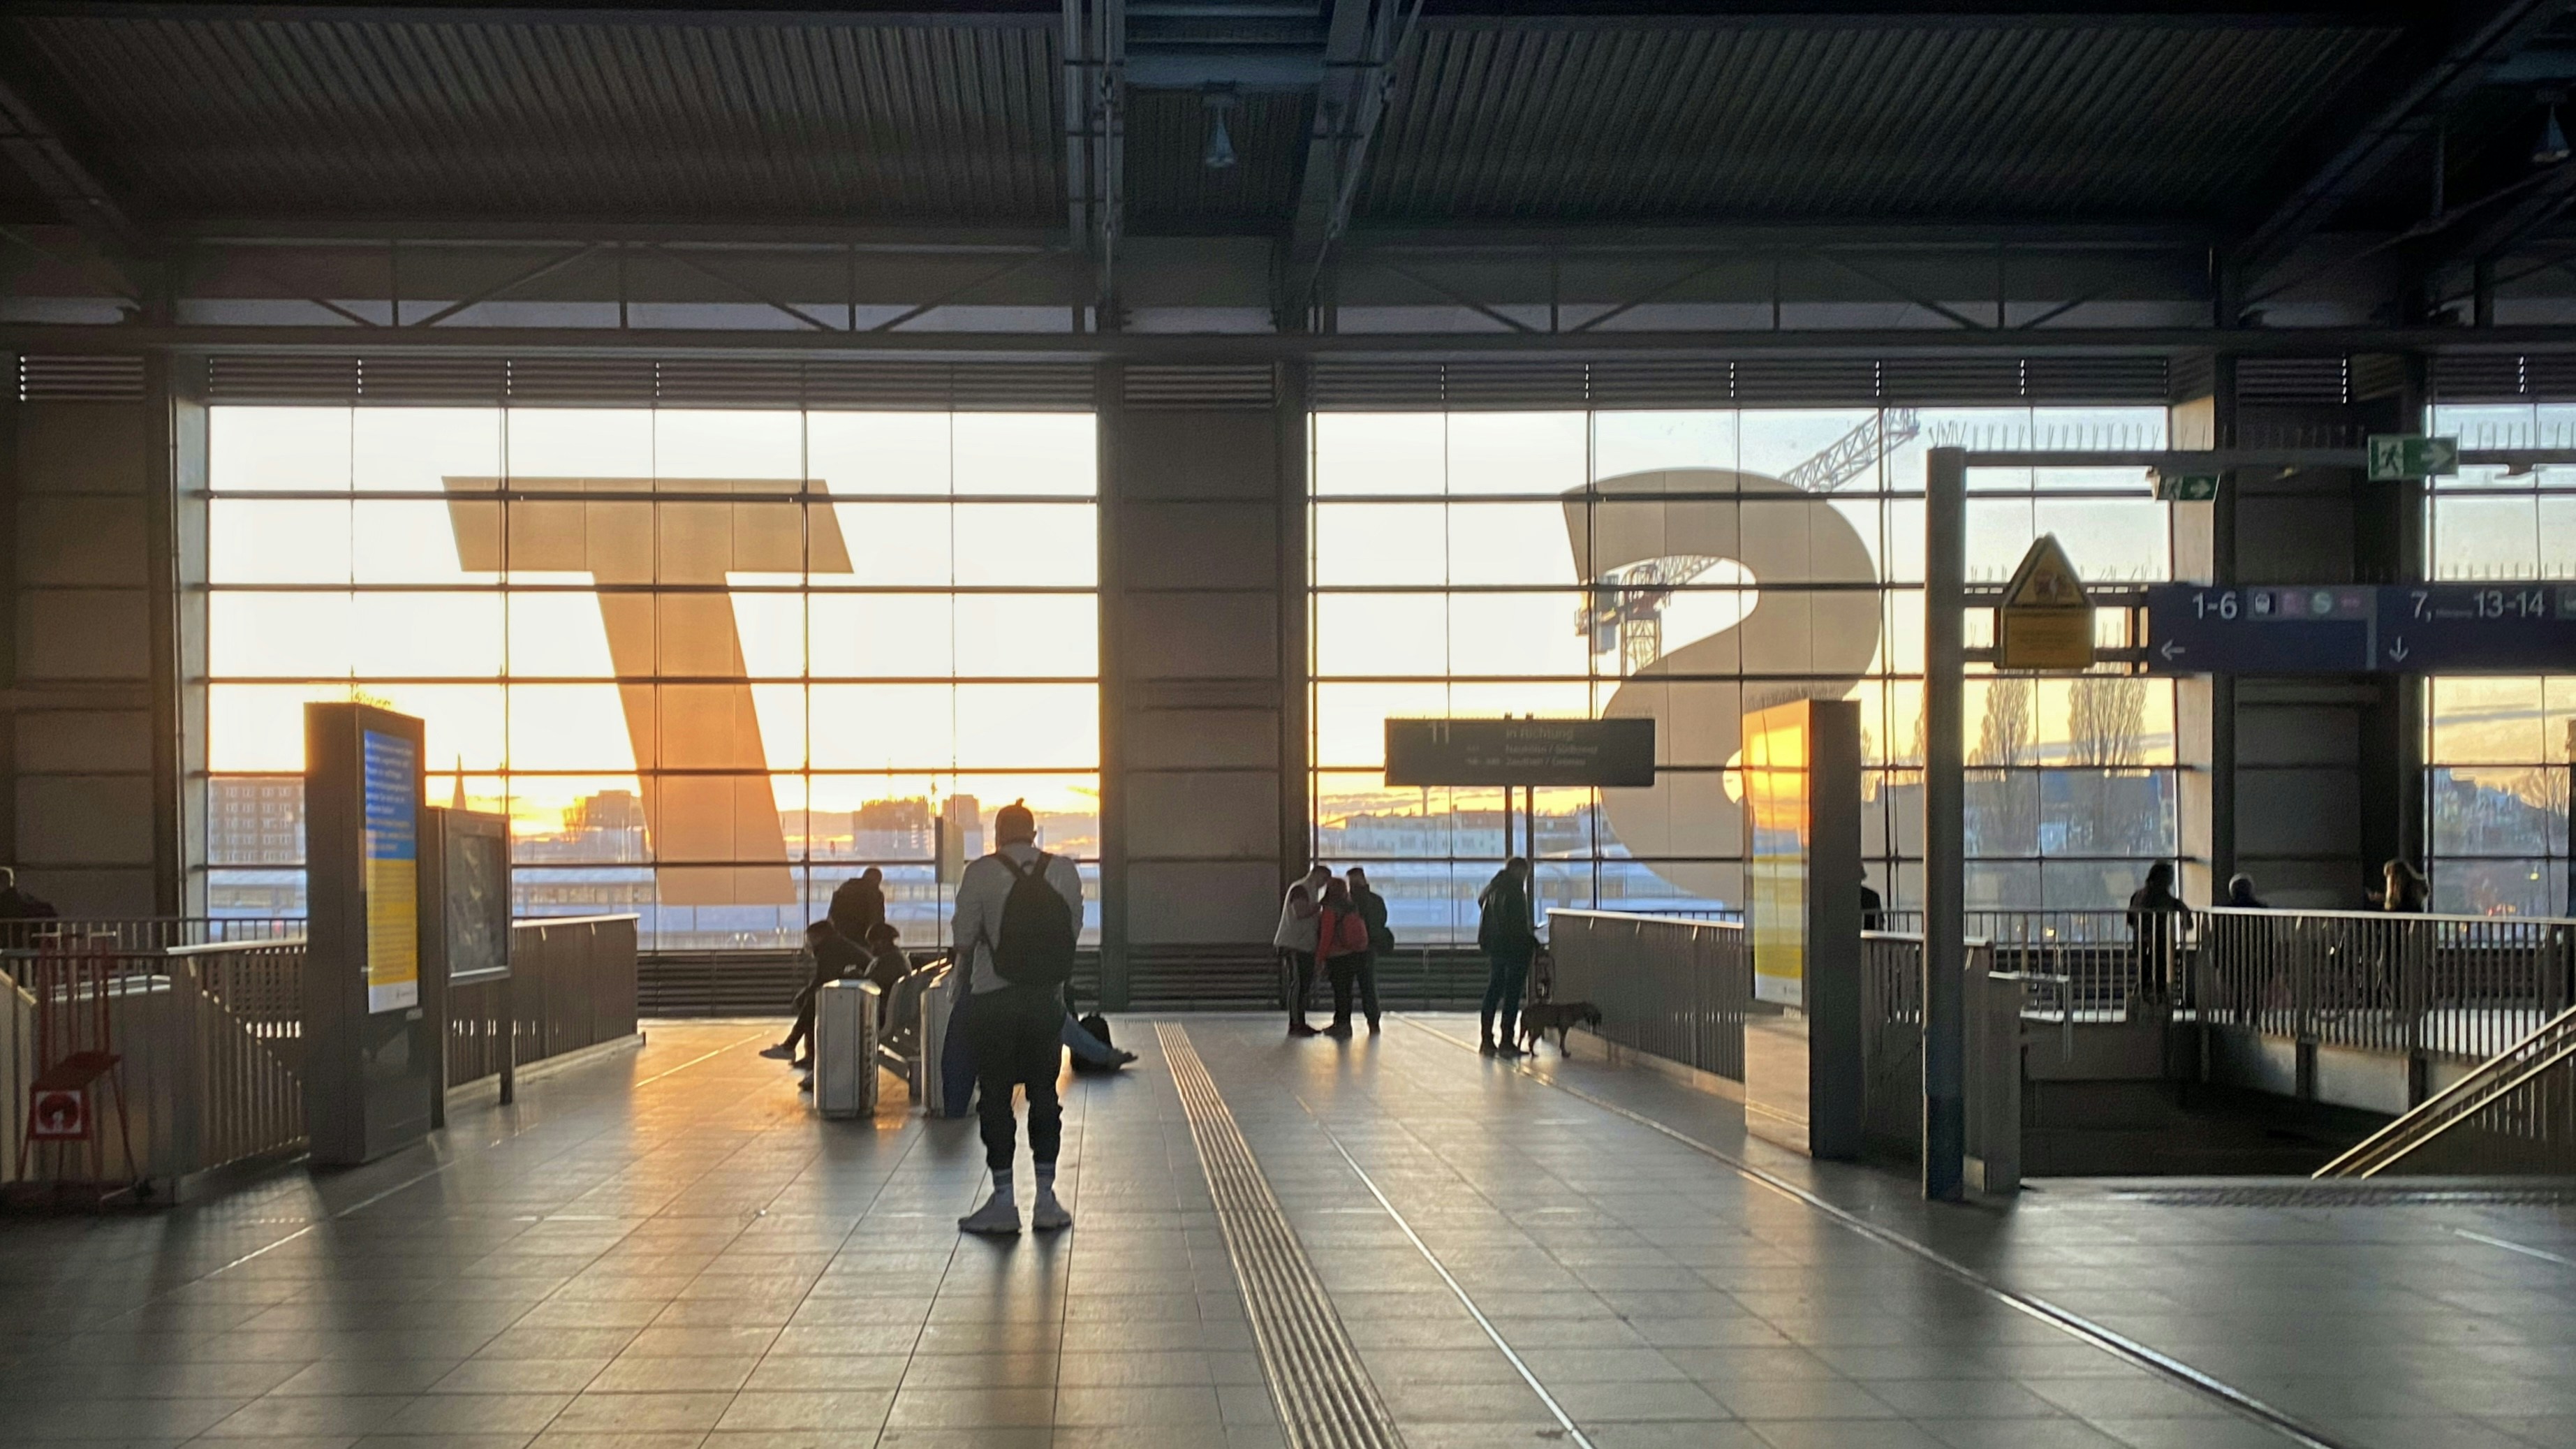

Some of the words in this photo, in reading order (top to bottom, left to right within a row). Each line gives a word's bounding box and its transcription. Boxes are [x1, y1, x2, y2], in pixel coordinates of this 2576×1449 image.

[2191, 591, 2238, 619] 1-6
[2473, 590, 2545, 619] 13-14
[1520, 727, 1574, 742] Richtung
